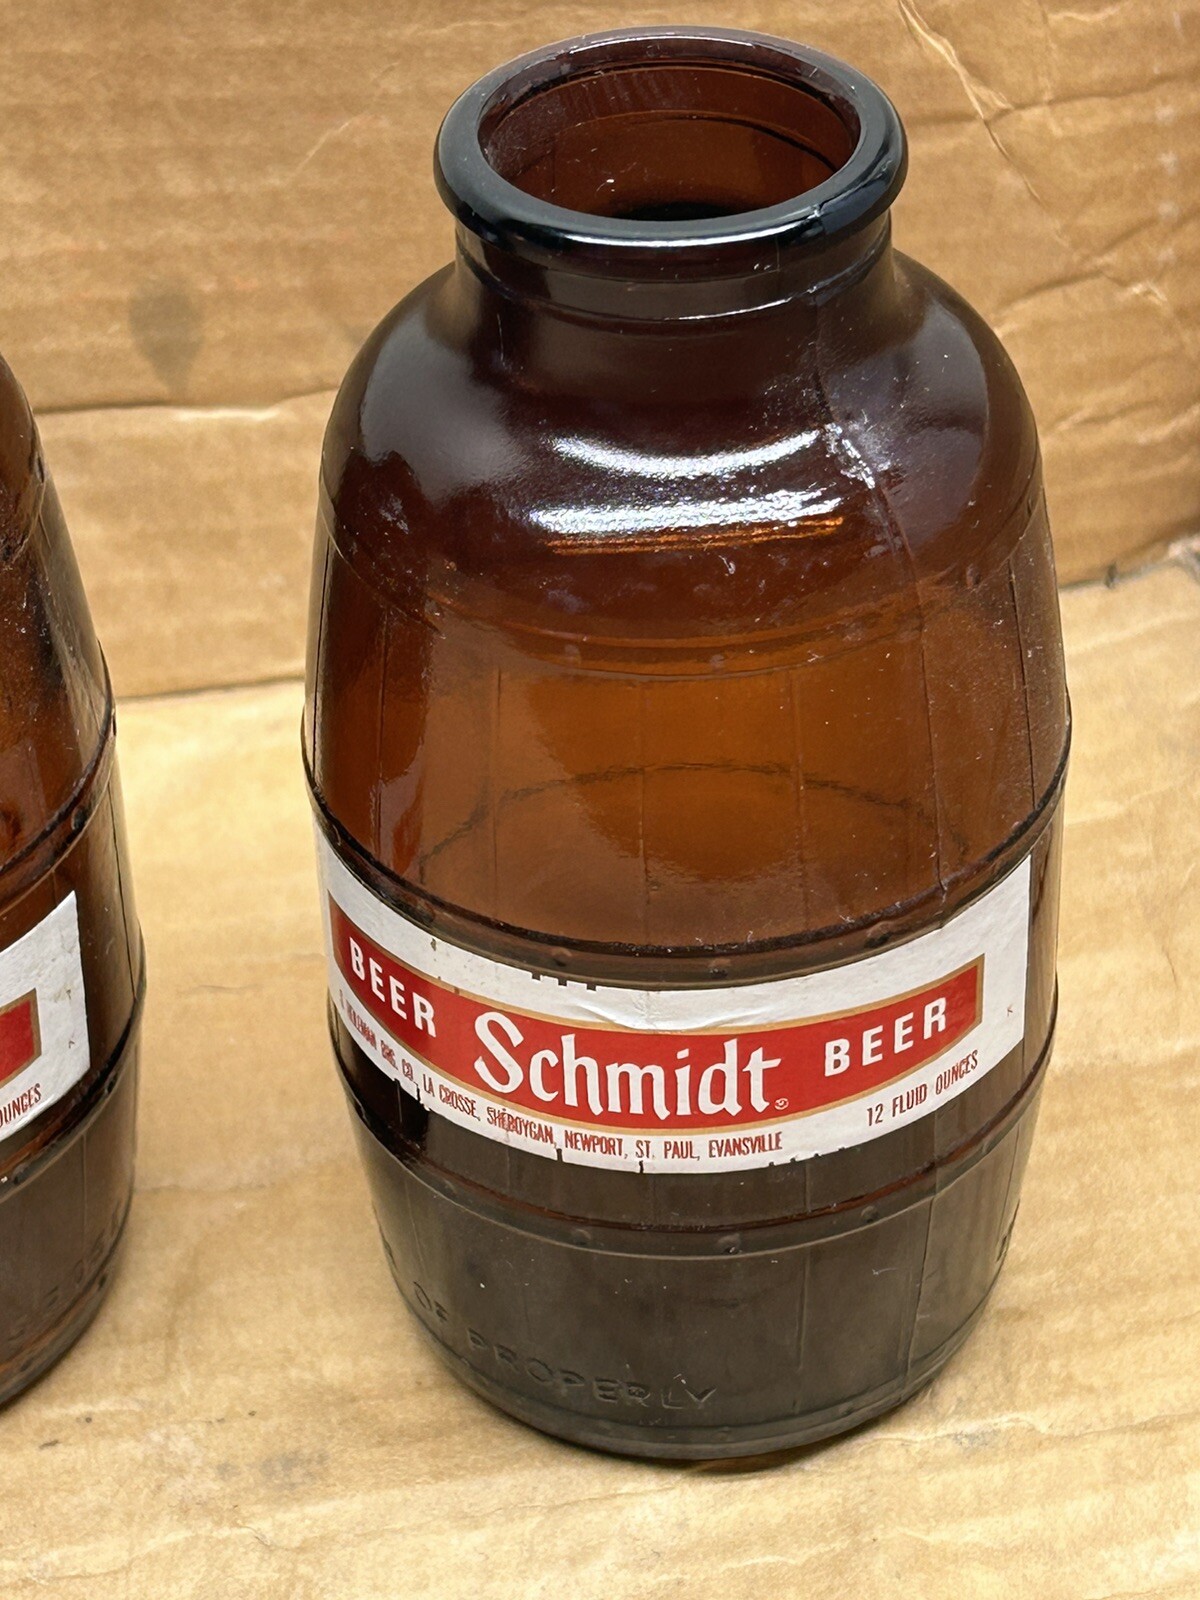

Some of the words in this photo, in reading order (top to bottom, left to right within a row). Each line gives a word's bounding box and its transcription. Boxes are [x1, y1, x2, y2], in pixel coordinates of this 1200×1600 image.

[348, 936, 437, 1039] BEER
[473, 1010, 782, 1121] Schmidt
[823, 996, 948, 1078] BEER
[422, 1073, 435, 1098] LA
[439, 1084, 481, 1122] CROSSE,
[564, 1129, 628, 1160] NEWPORT,
[635, 1140, 656, 1159] ST.
[663, 1140, 701, 1161] PAUL,
[708, 1131, 783, 1158] EVANSVILLE
[866, 1103, 884, 1127] 12
[892, 1083, 928, 1118] FLUID
[935, 1049, 979, 1095] OUNCES
[467, 1327, 718, 1411] PROPERLY
